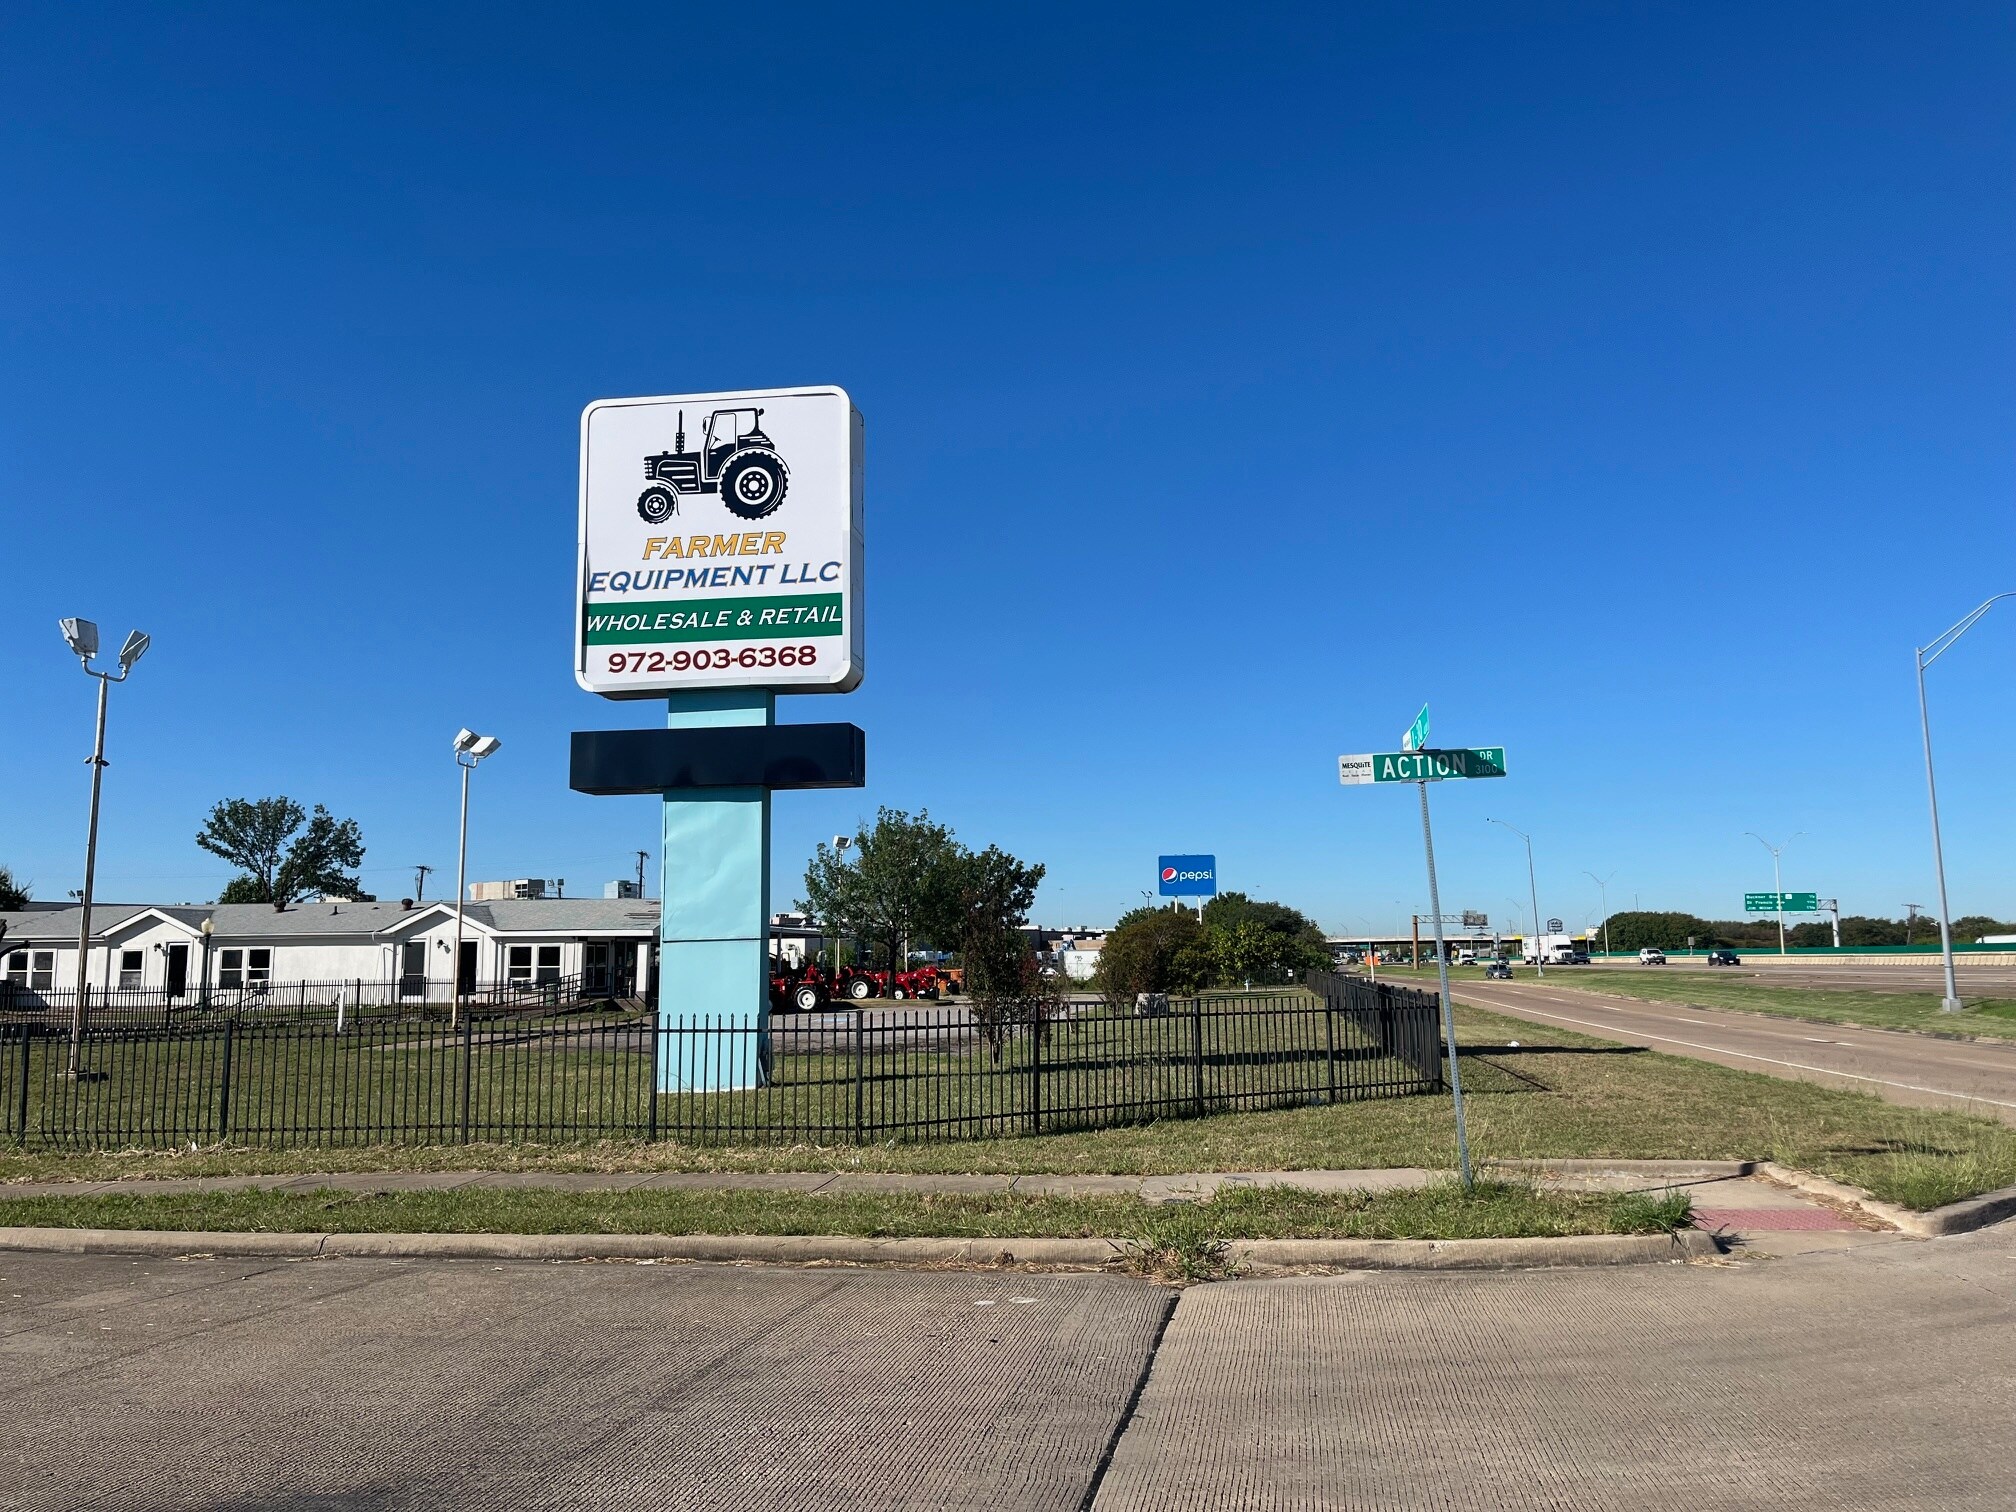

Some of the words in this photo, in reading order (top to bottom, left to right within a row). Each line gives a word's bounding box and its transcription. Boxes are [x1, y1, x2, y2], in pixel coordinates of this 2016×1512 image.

[642, 531, 787, 561] FARMER
[587, 563, 776, 595] EQUIPMENT
[779, 561, 843, 585] LLC
[586, 609, 733, 632] WHOLESALE
[736, 609, 754, 626] &
[758, 605, 843, 626] RETAIL
[608, 645, 817, 673] 972-903-6368
[1382, 753, 1467, 779] ACTION
[1479, 750, 1494, 761] DR
[1179, 868, 1212, 882] pepsi
